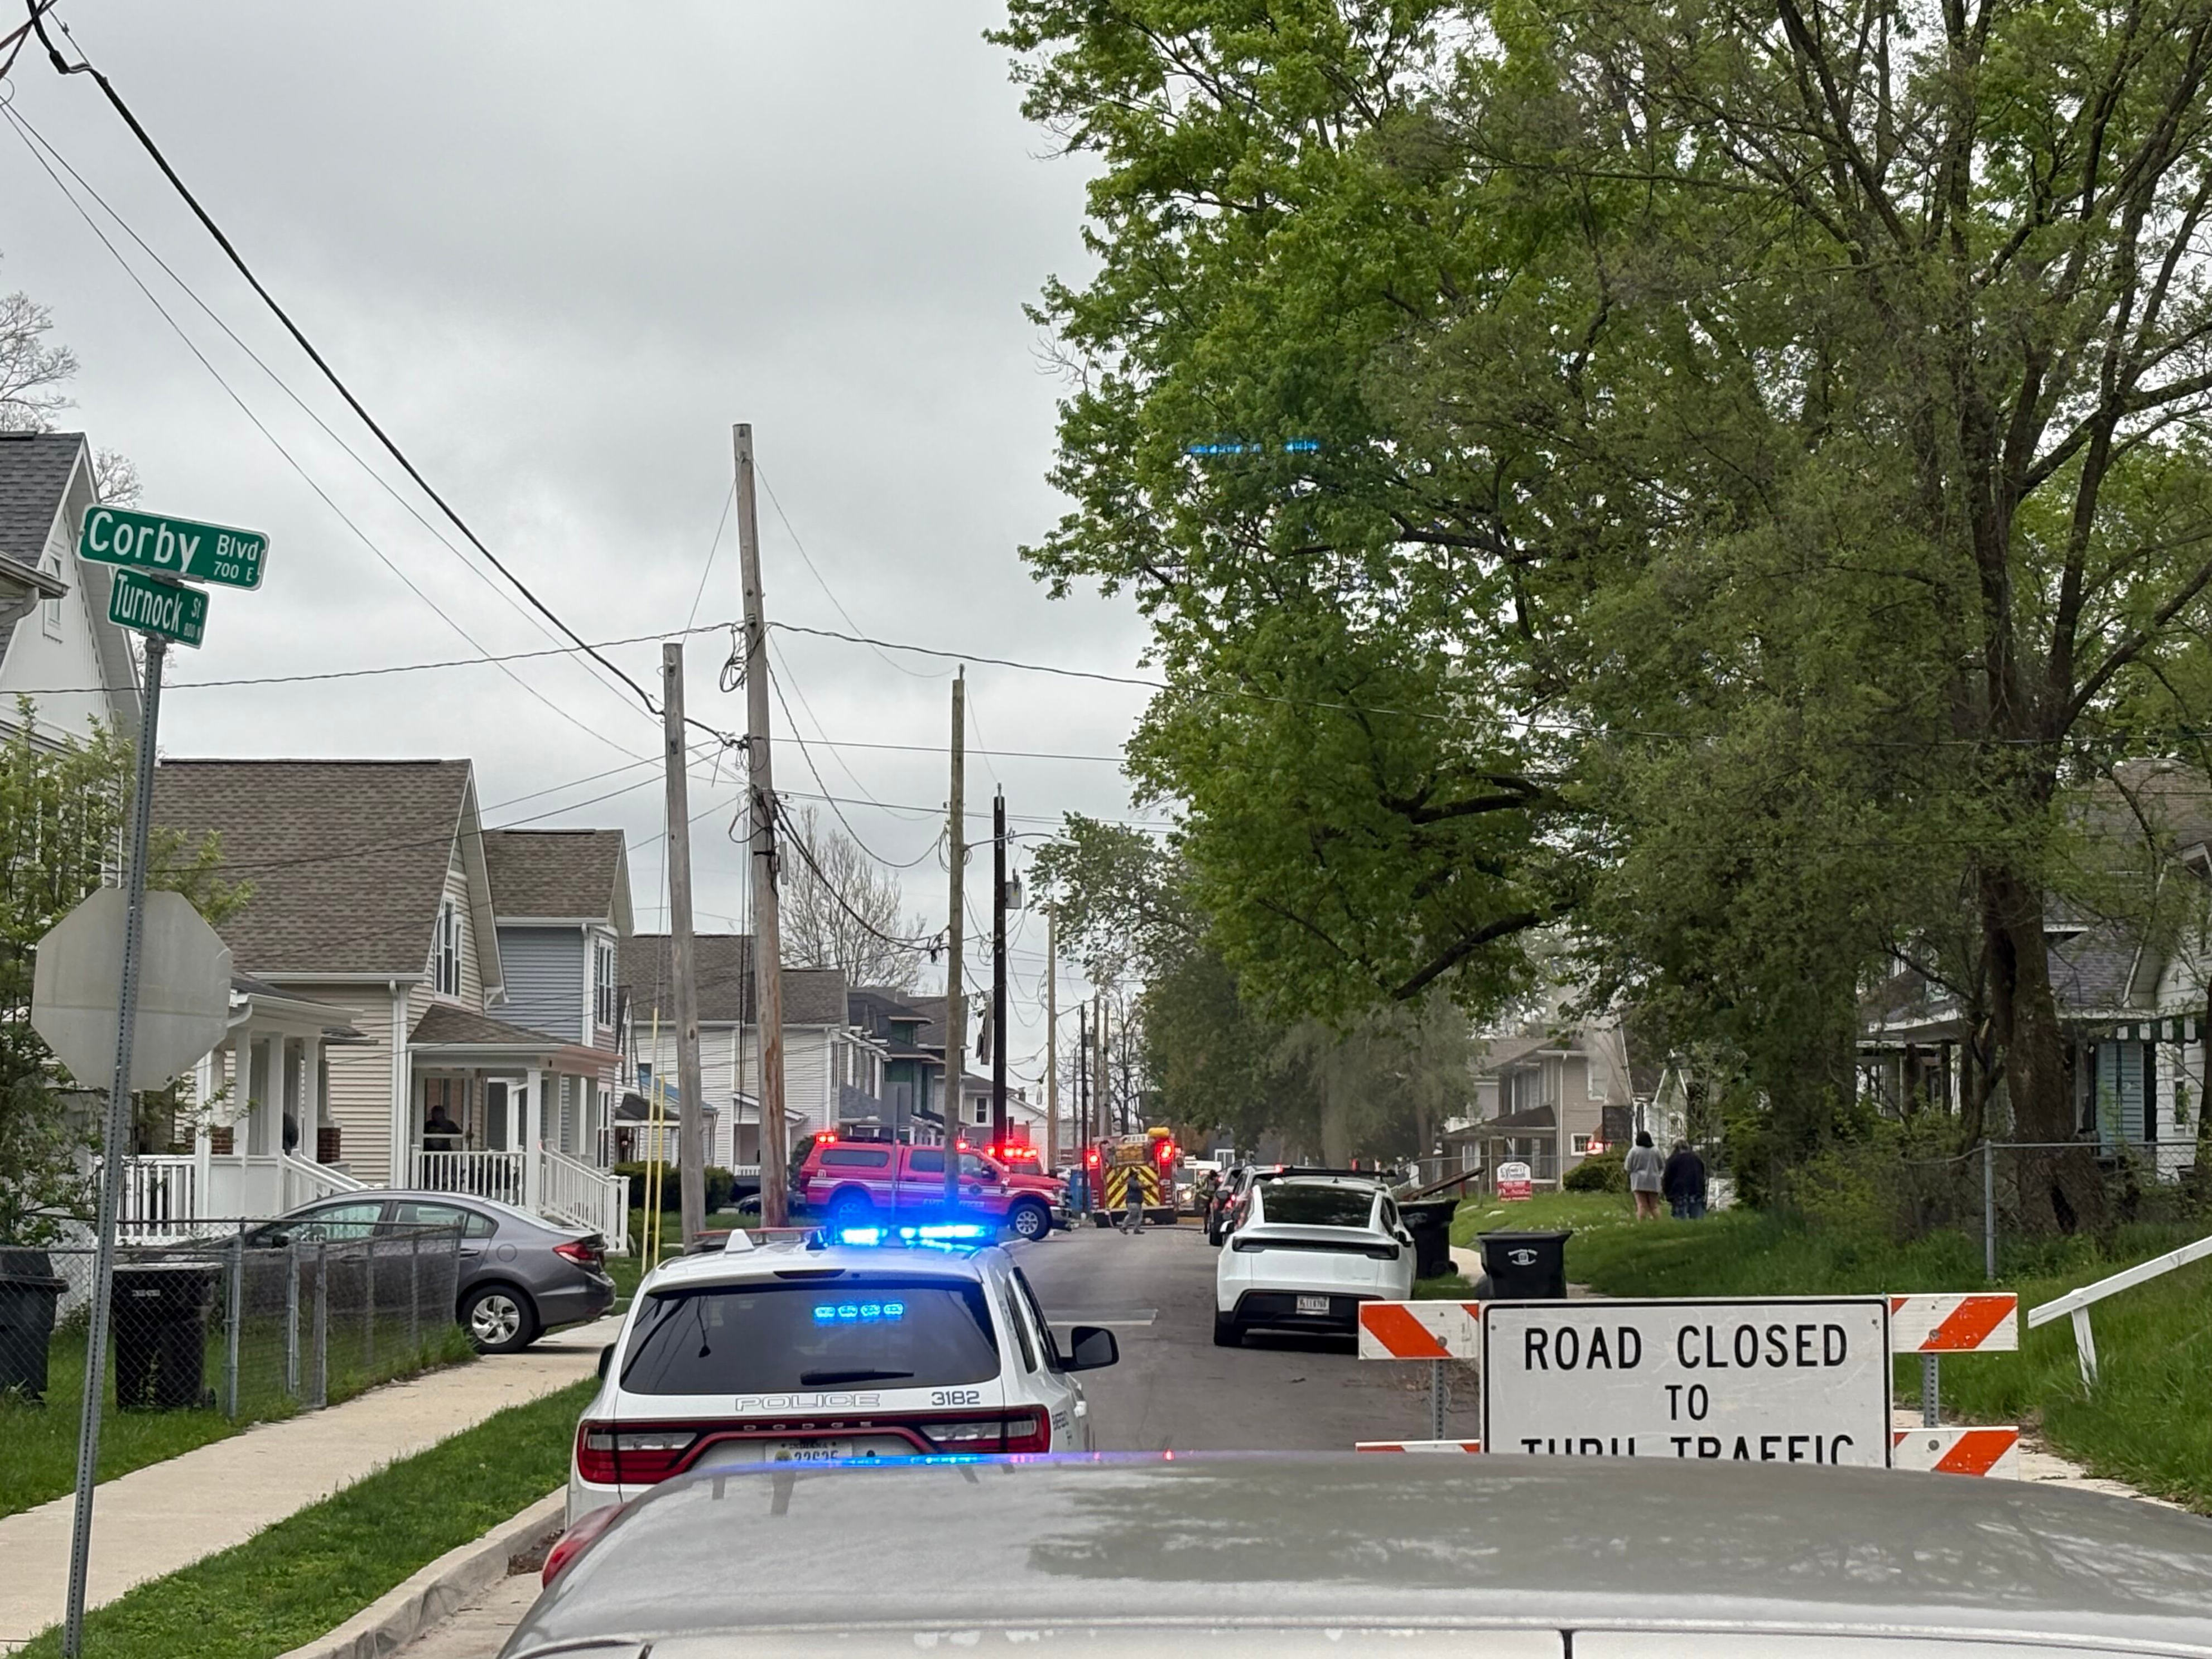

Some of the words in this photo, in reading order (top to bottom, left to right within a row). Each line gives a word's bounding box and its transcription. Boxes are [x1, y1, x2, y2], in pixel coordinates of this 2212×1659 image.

[89, 511, 201, 573] Corby
[216, 534, 259, 562] Blvd
[213, 561, 239, 579] 700
[246, 567, 254, 582] E
[115, 573, 184, 633] Turnock
[191, 597, 202, 619] St
[1525, 1326, 1642, 1371] ROAD
[1677, 1324, 1847, 1369] CLOSED
[735, 1393, 881, 1412] POLICE
[931, 1390, 981, 1406] 3182
[1665, 1384, 1709, 1421] TO
[743, 1420, 873, 1431] DODGE
